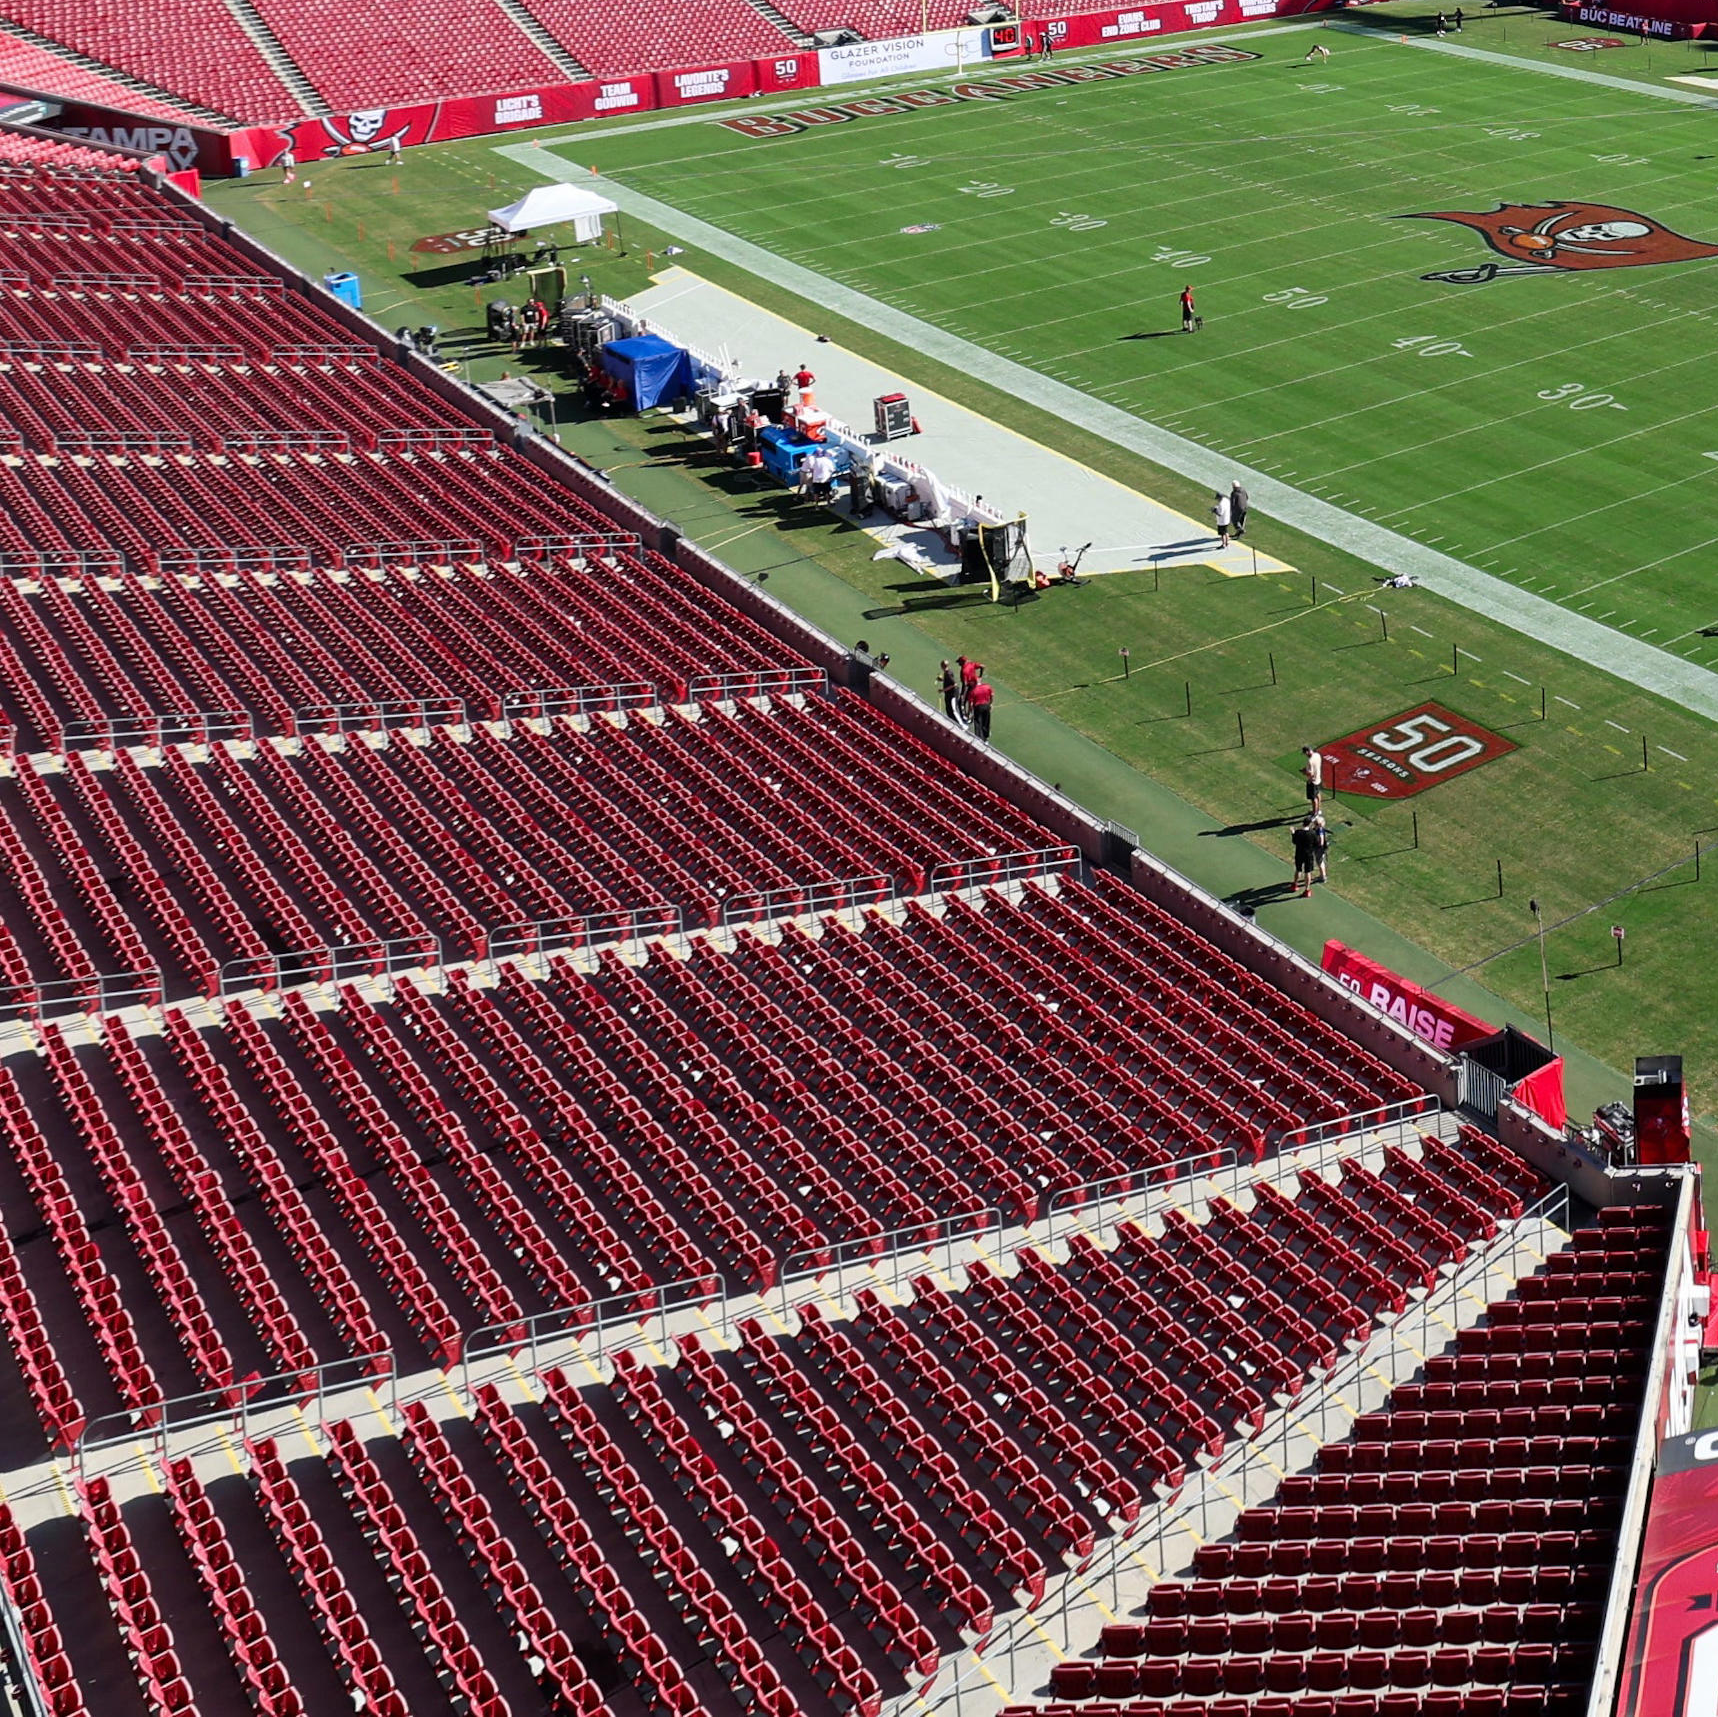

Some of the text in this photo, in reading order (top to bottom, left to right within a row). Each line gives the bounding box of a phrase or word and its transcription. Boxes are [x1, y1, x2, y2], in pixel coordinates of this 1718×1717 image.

[1117, 11, 1145, 26] EVANS
[1192, 11, 1218, 25] TROOP
[1580, 8, 1607, 23] BUC
[1048, 21, 1067, 36] 50
[1101, 19, 1161, 38] END ZONE CLUB
[830, 38, 924, 60] GLAZER VISION
[775, 59, 797, 76] 50
[848, 52, 910, 68] FOUNDATION
[675, 68, 730, 87] LAVONTE'S
[600, 82, 631, 97] TEAM
[679, 80, 725, 98] LEGENDS
[703, 44, 1262, 140] BUCCANEERS
[495, 94, 540, 113] LIGHT'S
[594, 94, 638, 112] GODWIN
[494, 106, 543, 125] BRIGADE
[1048, 213, 1109, 231] 30
[1149, 248, 1212, 269] 40
[1262, 285, 1329, 310] 50
[1390, 333, 1465, 359] 40
[1536, 382, 1616, 412] 30
[1372, 714, 1485, 773] 50
[1356, 747, 1411, 779] SEASONS
[1370, 982, 1455, 1049] RAISE
